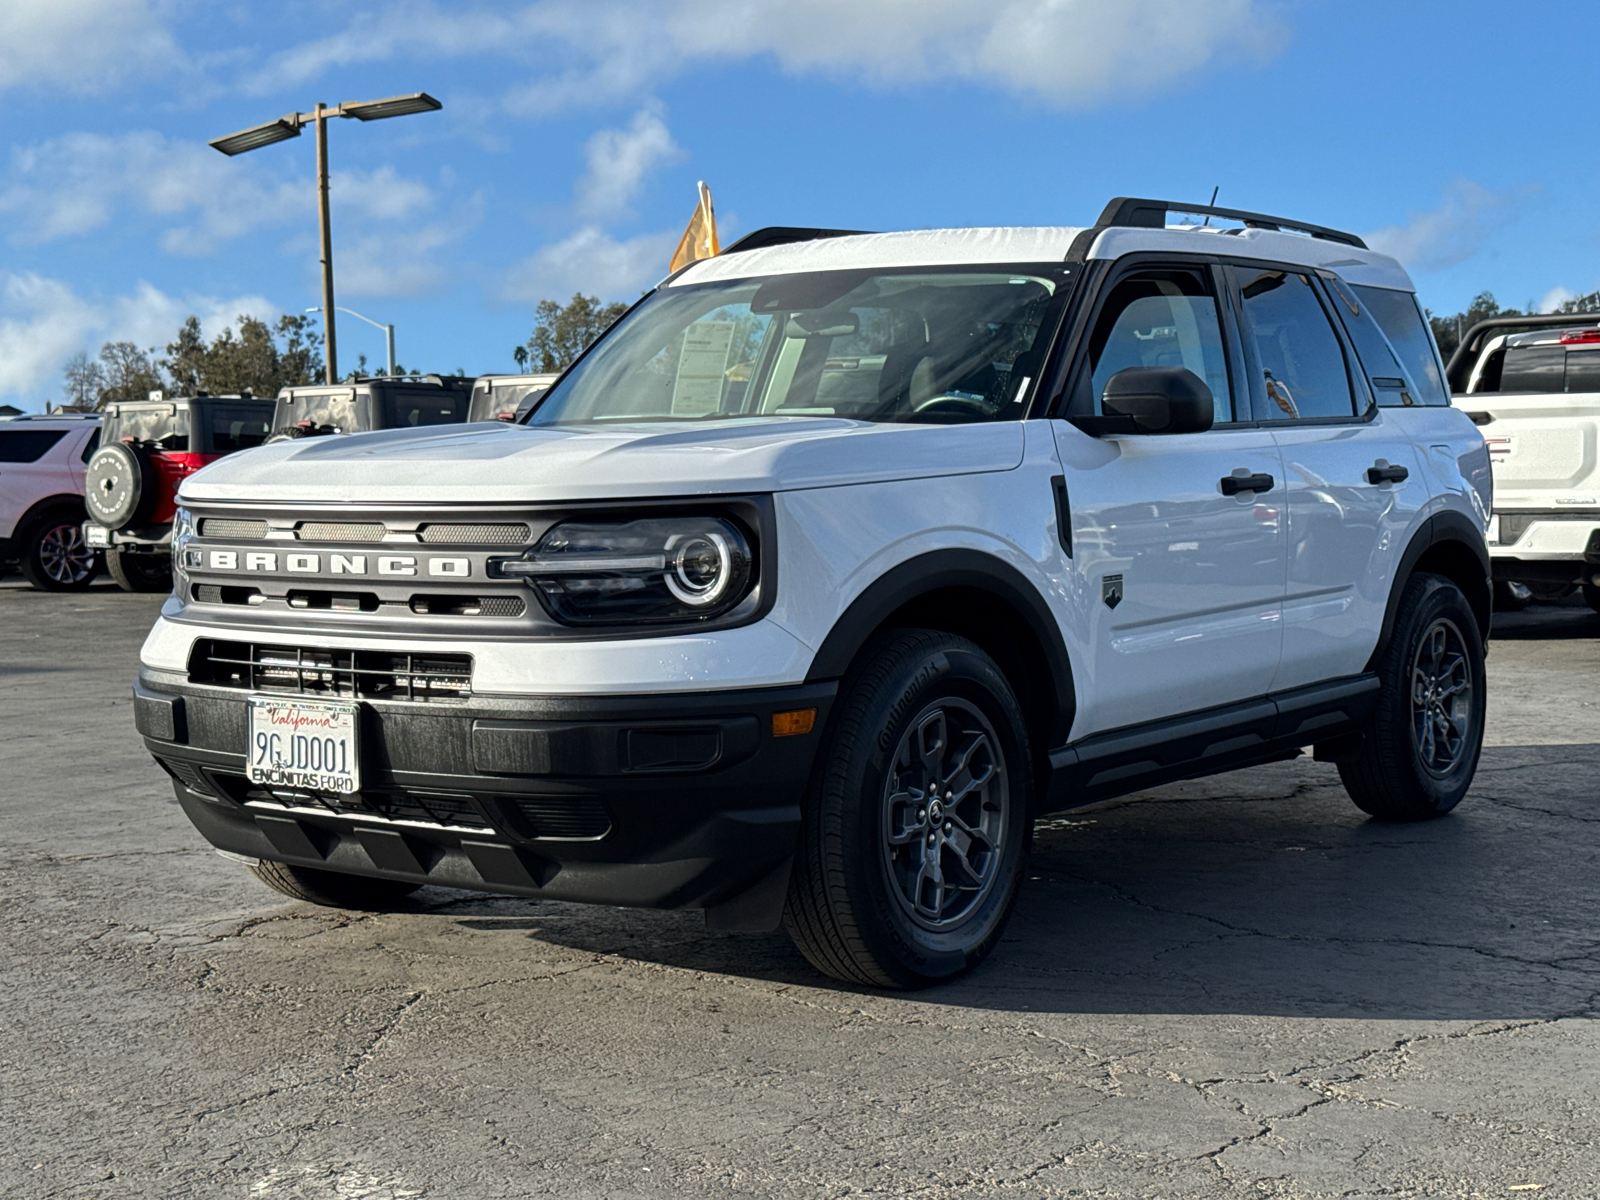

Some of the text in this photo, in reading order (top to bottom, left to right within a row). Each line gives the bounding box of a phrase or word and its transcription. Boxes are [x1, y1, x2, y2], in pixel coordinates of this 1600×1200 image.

[93, 457, 122, 471] FORD
[91, 491, 126, 514] BRONCO
[209, 550, 471, 577] BRONCO
[271, 707, 338, 732] California
[877, 665, 932, 753] Continental
[256, 731, 351, 775] 9GJD001
[252, 768, 354, 792] ENCINITAS FORD
